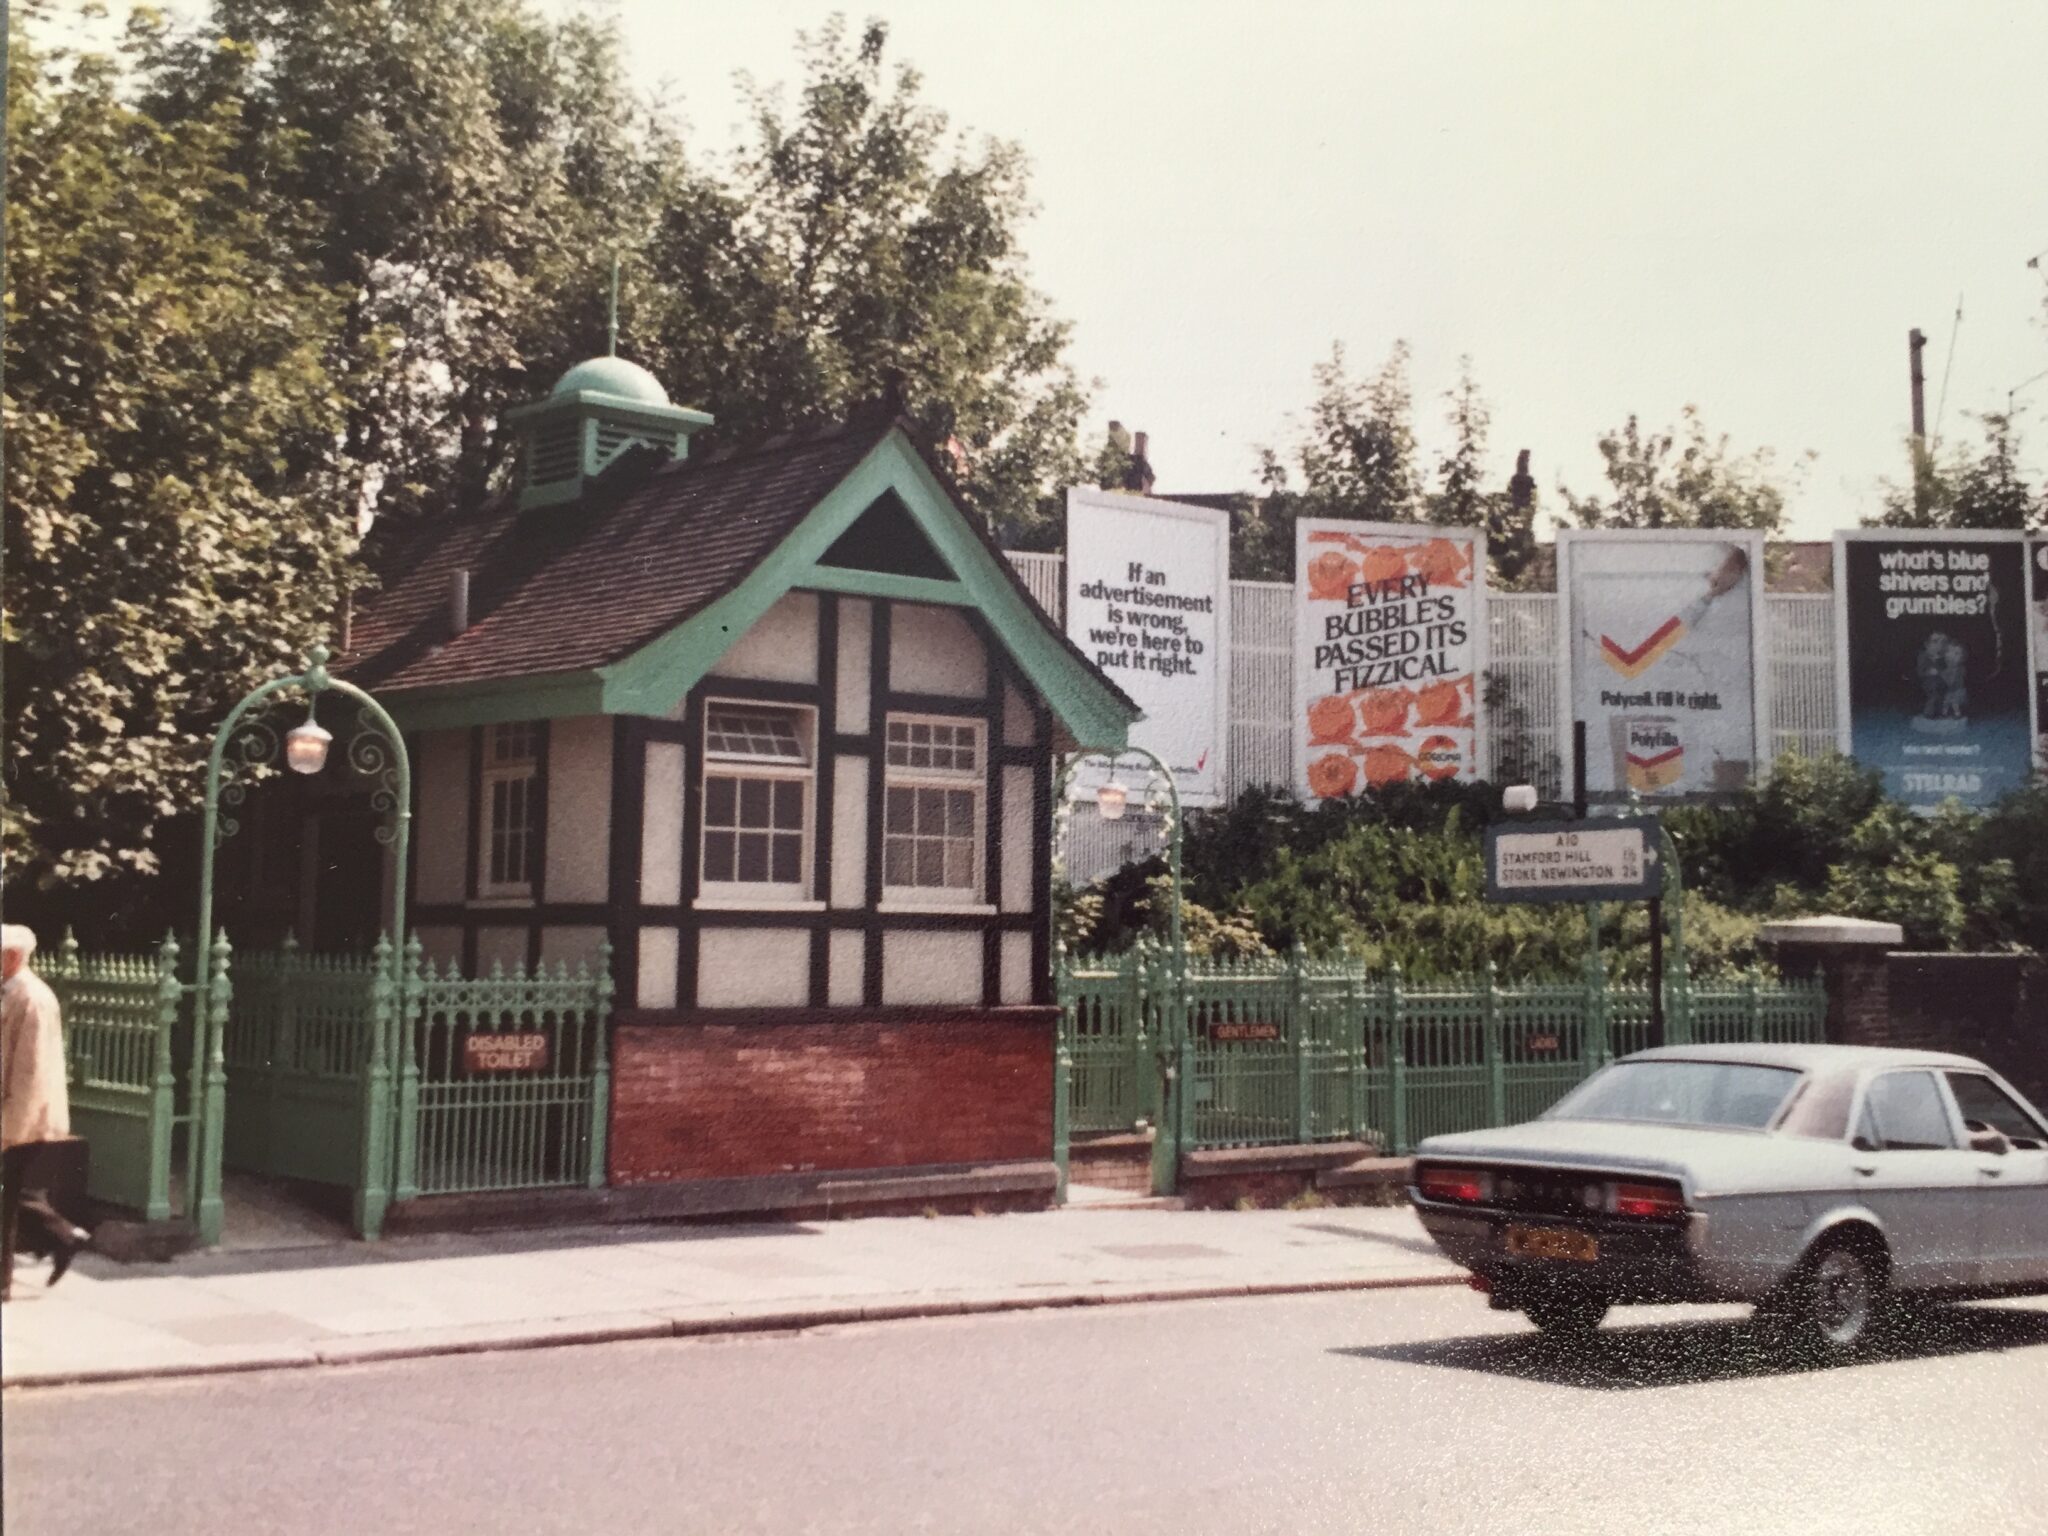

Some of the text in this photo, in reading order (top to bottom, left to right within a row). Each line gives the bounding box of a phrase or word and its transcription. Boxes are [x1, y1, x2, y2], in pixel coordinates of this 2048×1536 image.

[1879, 549, 1990, 570] what's blue
[1128, 562, 1166, 586] If an
[1879, 571, 1990, 592] shivers and
[1079, 580, 1213, 614] advertisement
[1347, 574, 1430, 609] EVERY
[1107, 603, 1188, 635] is wrong,
[1325, 595, 1456, 641] BUBBLE'S
[1886, 594, 1987, 619] grumbles?
[1089, 627, 1204, 655] we're here to
[1314, 621, 1467, 669] PASSED ITS
[1096, 650, 1197, 677] put it right.
[1335, 651, 1460, 694] FIZZICAL.
[1502, 850, 1592, 865] STAMFORD HILL
[1502, 867, 1537, 881] STOKE
[1541, 865, 1614, 879] NEWINGTON
[468, 1034, 545, 1052] DISABLED
[1217, 1025, 1277, 1039] GENTLEMEN
[478, 1052, 533, 1068] TOILET
